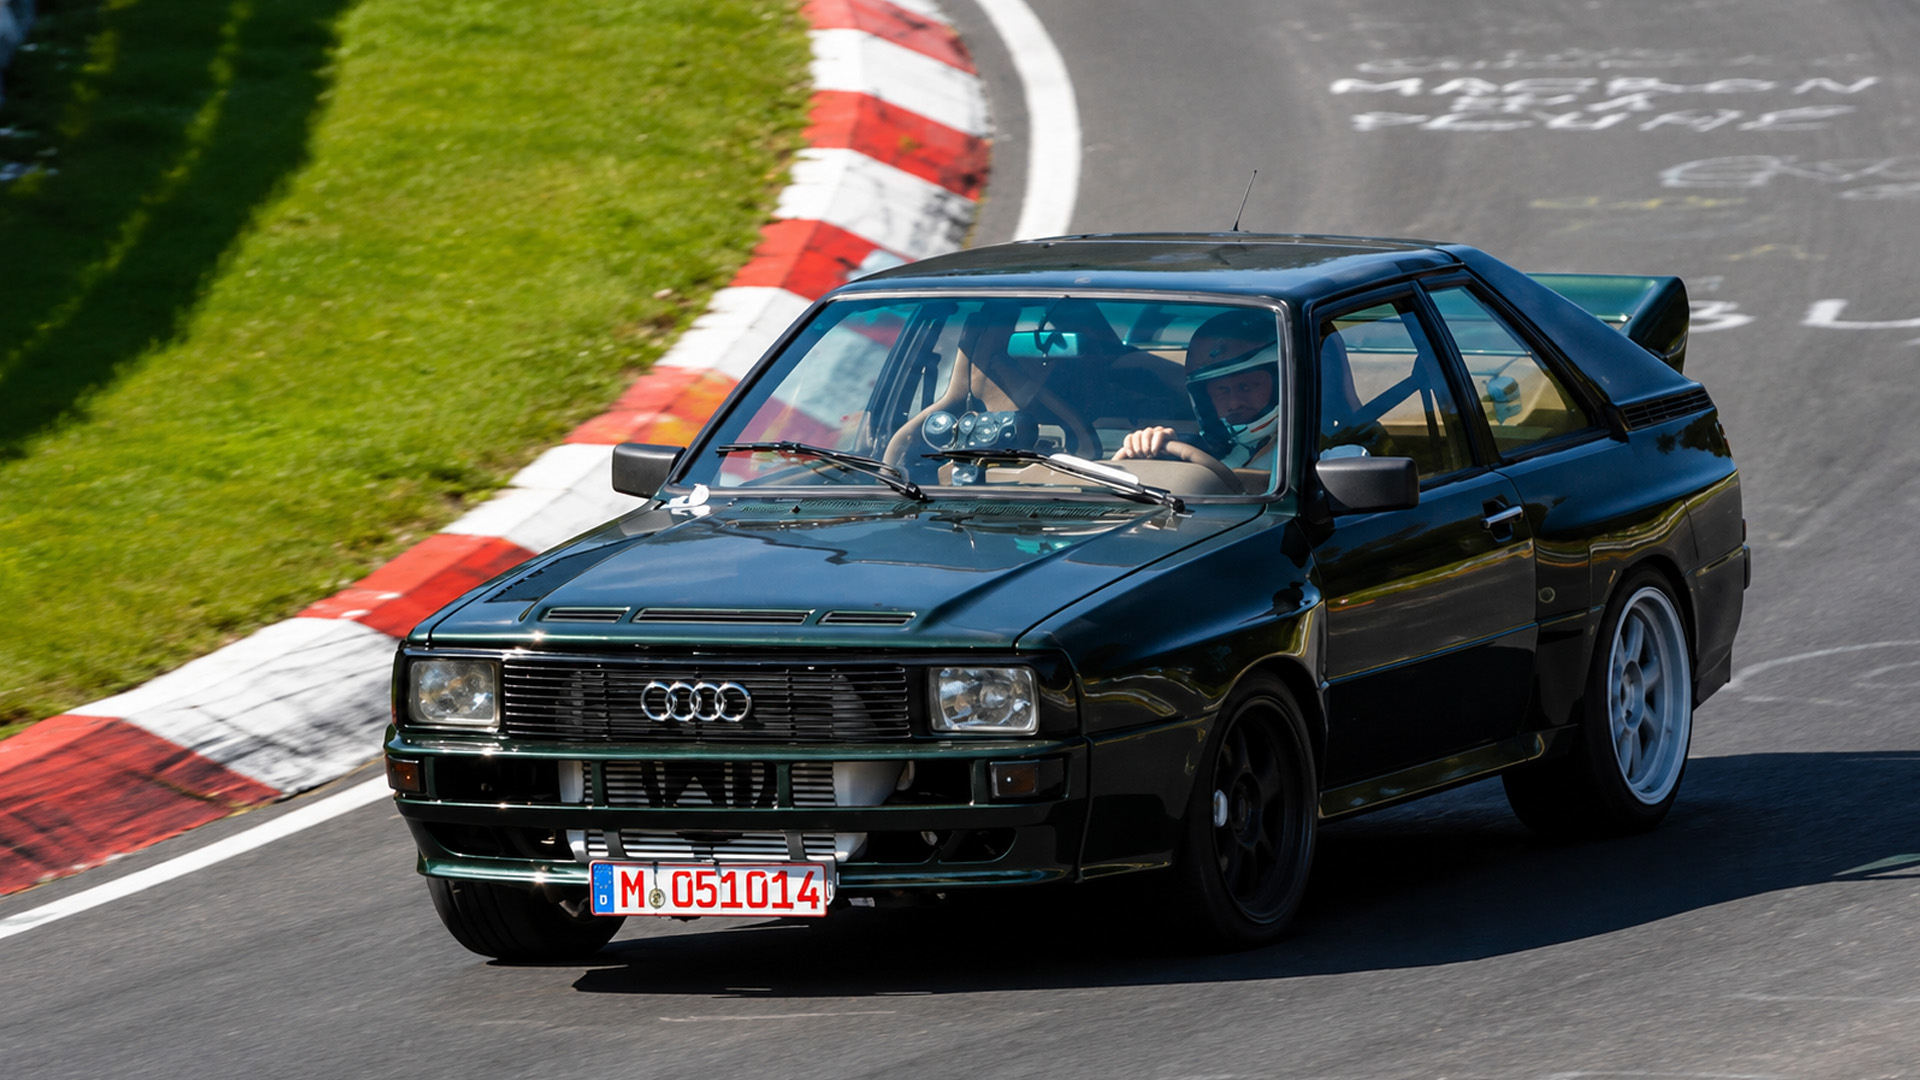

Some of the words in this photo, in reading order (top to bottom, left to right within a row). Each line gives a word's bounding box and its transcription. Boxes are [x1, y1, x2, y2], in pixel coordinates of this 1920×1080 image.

[599, 894, 608, 905] D
[621, 870, 645, 908] M
[672, 870, 820, 909] 051014
